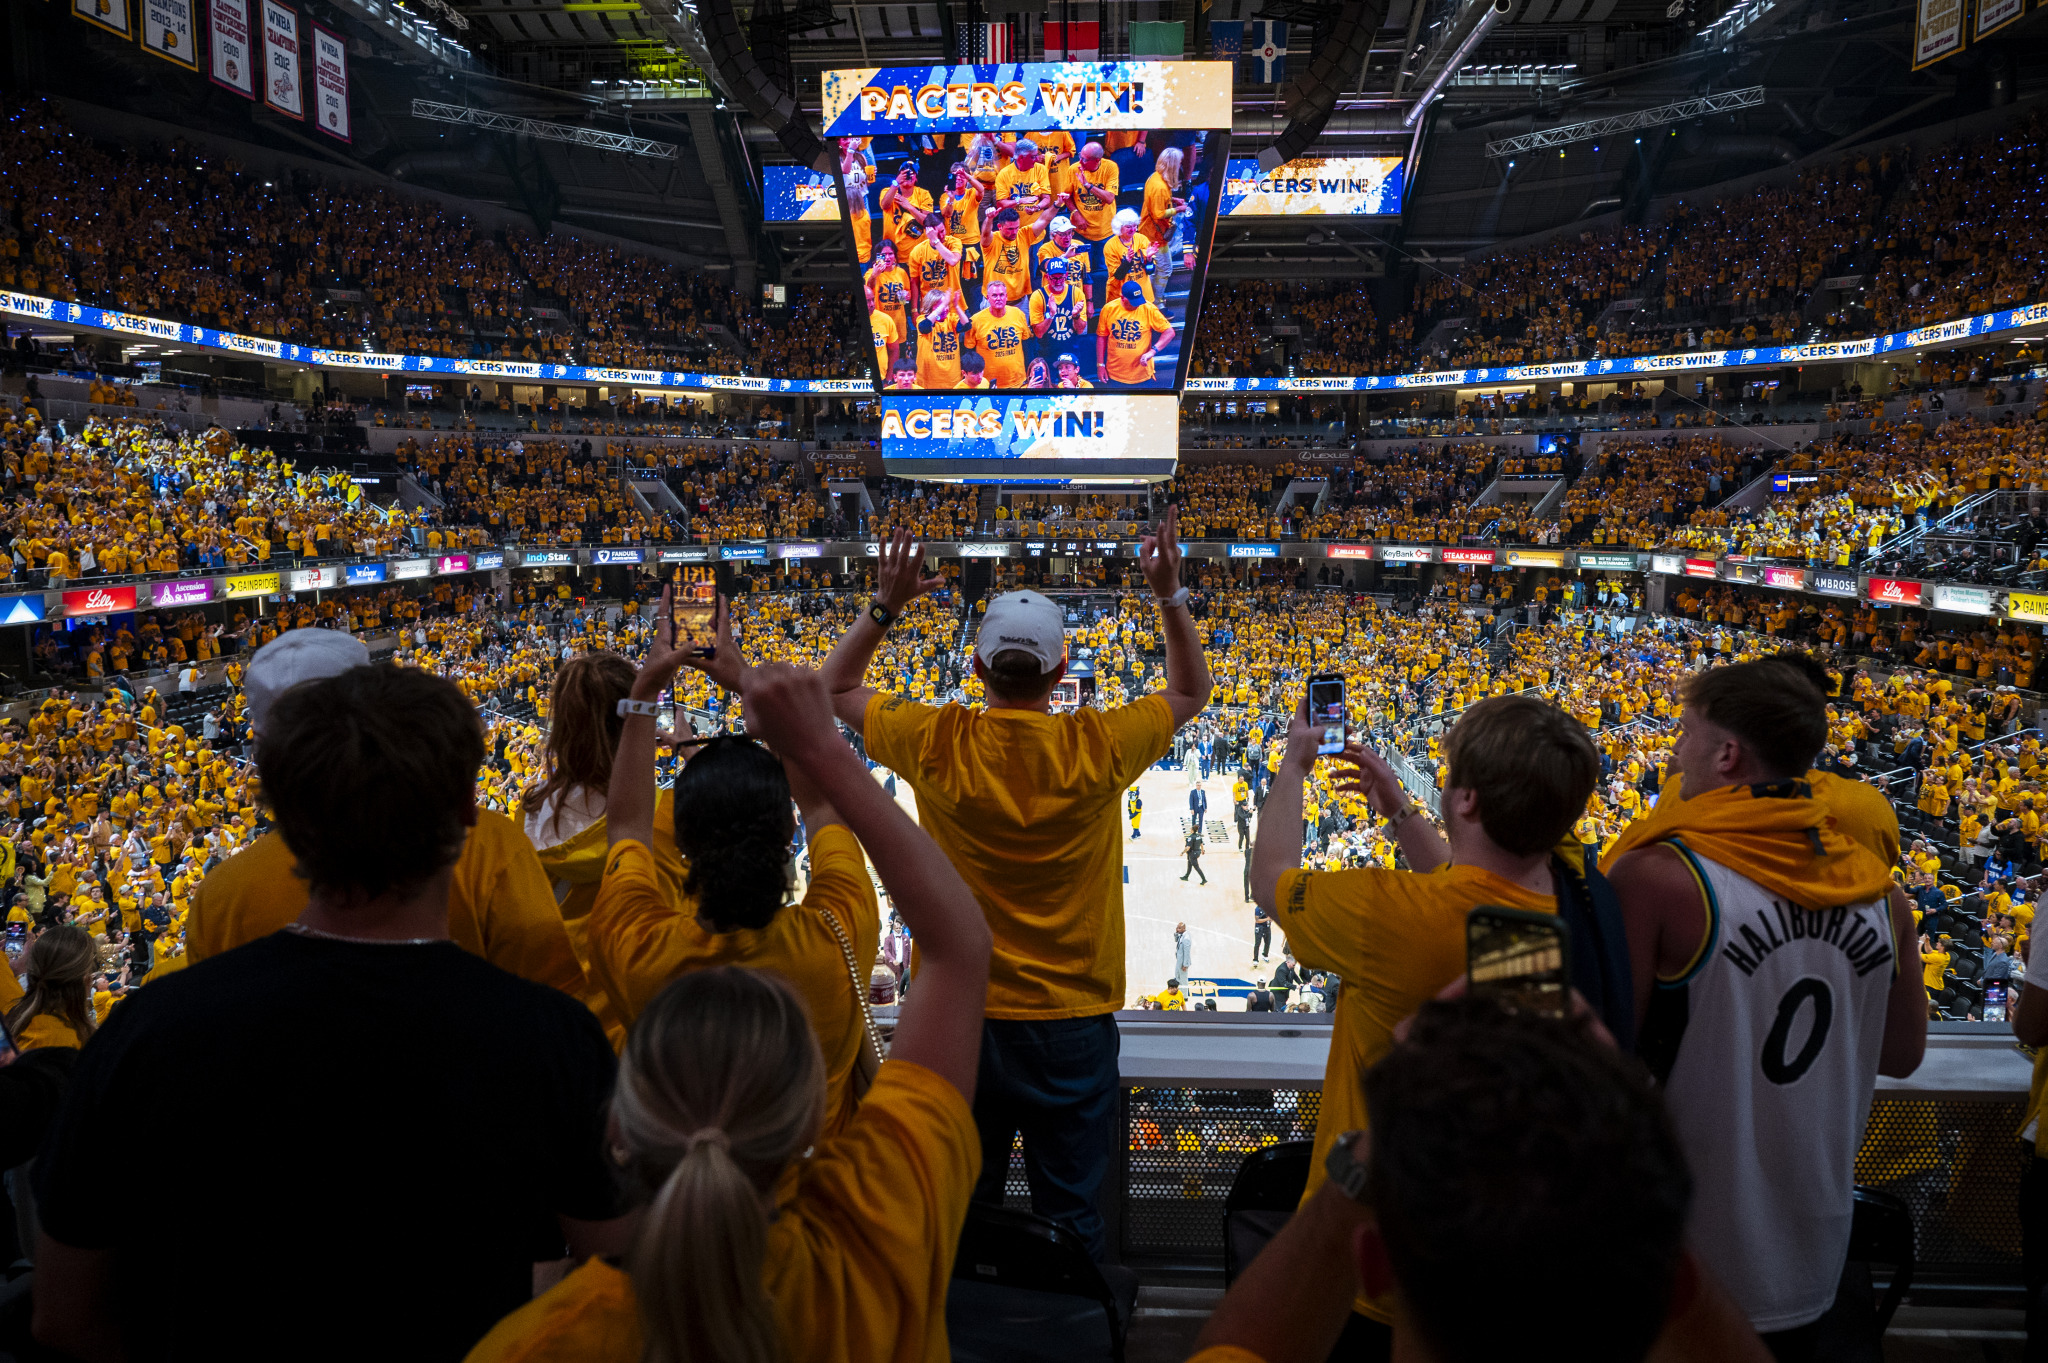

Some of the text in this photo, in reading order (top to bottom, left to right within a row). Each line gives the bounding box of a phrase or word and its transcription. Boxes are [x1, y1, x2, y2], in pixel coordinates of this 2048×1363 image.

[267, 7, 292, 33] WNBA
[223, 41, 239, 59] 2009
[321, 39, 339, 59] WNBA
[274, 52, 290, 71] 2012
[326, 94, 339, 109] 2015
[860, 80, 1145, 121] PACERS WIN!
[1227, 178, 1369, 196] PACERS WIN!
[1050, 261, 1063, 270] PAC
[12, 296, 45, 315] WIN!
[102, 311, 174, 337] PACERS WIN!
[1055, 316, 1067, 332] 12
[1117, 318, 1141, 331] YES
[937, 331, 955, 342] YES
[992, 327, 1016, 339] YES
[1906, 322, 1965, 346] PACERS WIN!
[219, 333, 276, 354] PACERS WIN!
[1780, 341, 1870, 360] PACERS WIN!
[311, 350, 395, 367] PACERS WIN!
[1633, 353, 1718, 370] PACERS WIN!
[454, 360, 534, 375] PACERS WIN!
[586, 368, 656, 382] PACERS WIN!
[1506, 364, 1579, 379] PACERS WIN!
[702, 376, 764, 388] PACERS WIN!
[809, 381, 873, 391] PACERS WIN
[1203, 379, 1229, 389] WIN!
[1278, 378, 1348, 389] PACERS WIN!
[1395, 373, 1459, 386] PACERS WIN!
[881, 408, 1104, 439] ACERS WIN!
[1231, 545, 1255, 556] ksm
[1384, 550, 1413, 559] KeyBank
[1444, 551, 1464, 560] STEAK
[1470, 552, 1493, 561] SHAKE
[237, 577, 278, 592] GAINBRIDGE
[1780, 572, 1795, 585] mhs
[1814, 577, 1856, 592] AMBROSE
[174, 581, 206, 593] Ascension
[1882, 581, 1904, 601] Lilly
[1965, 588, 1984, 598] Manning
[86, 590, 116, 612] Lilly
[1722, 900, 1892, 978] HALIBURTON
[1760, 977, 1833, 1086] 0
